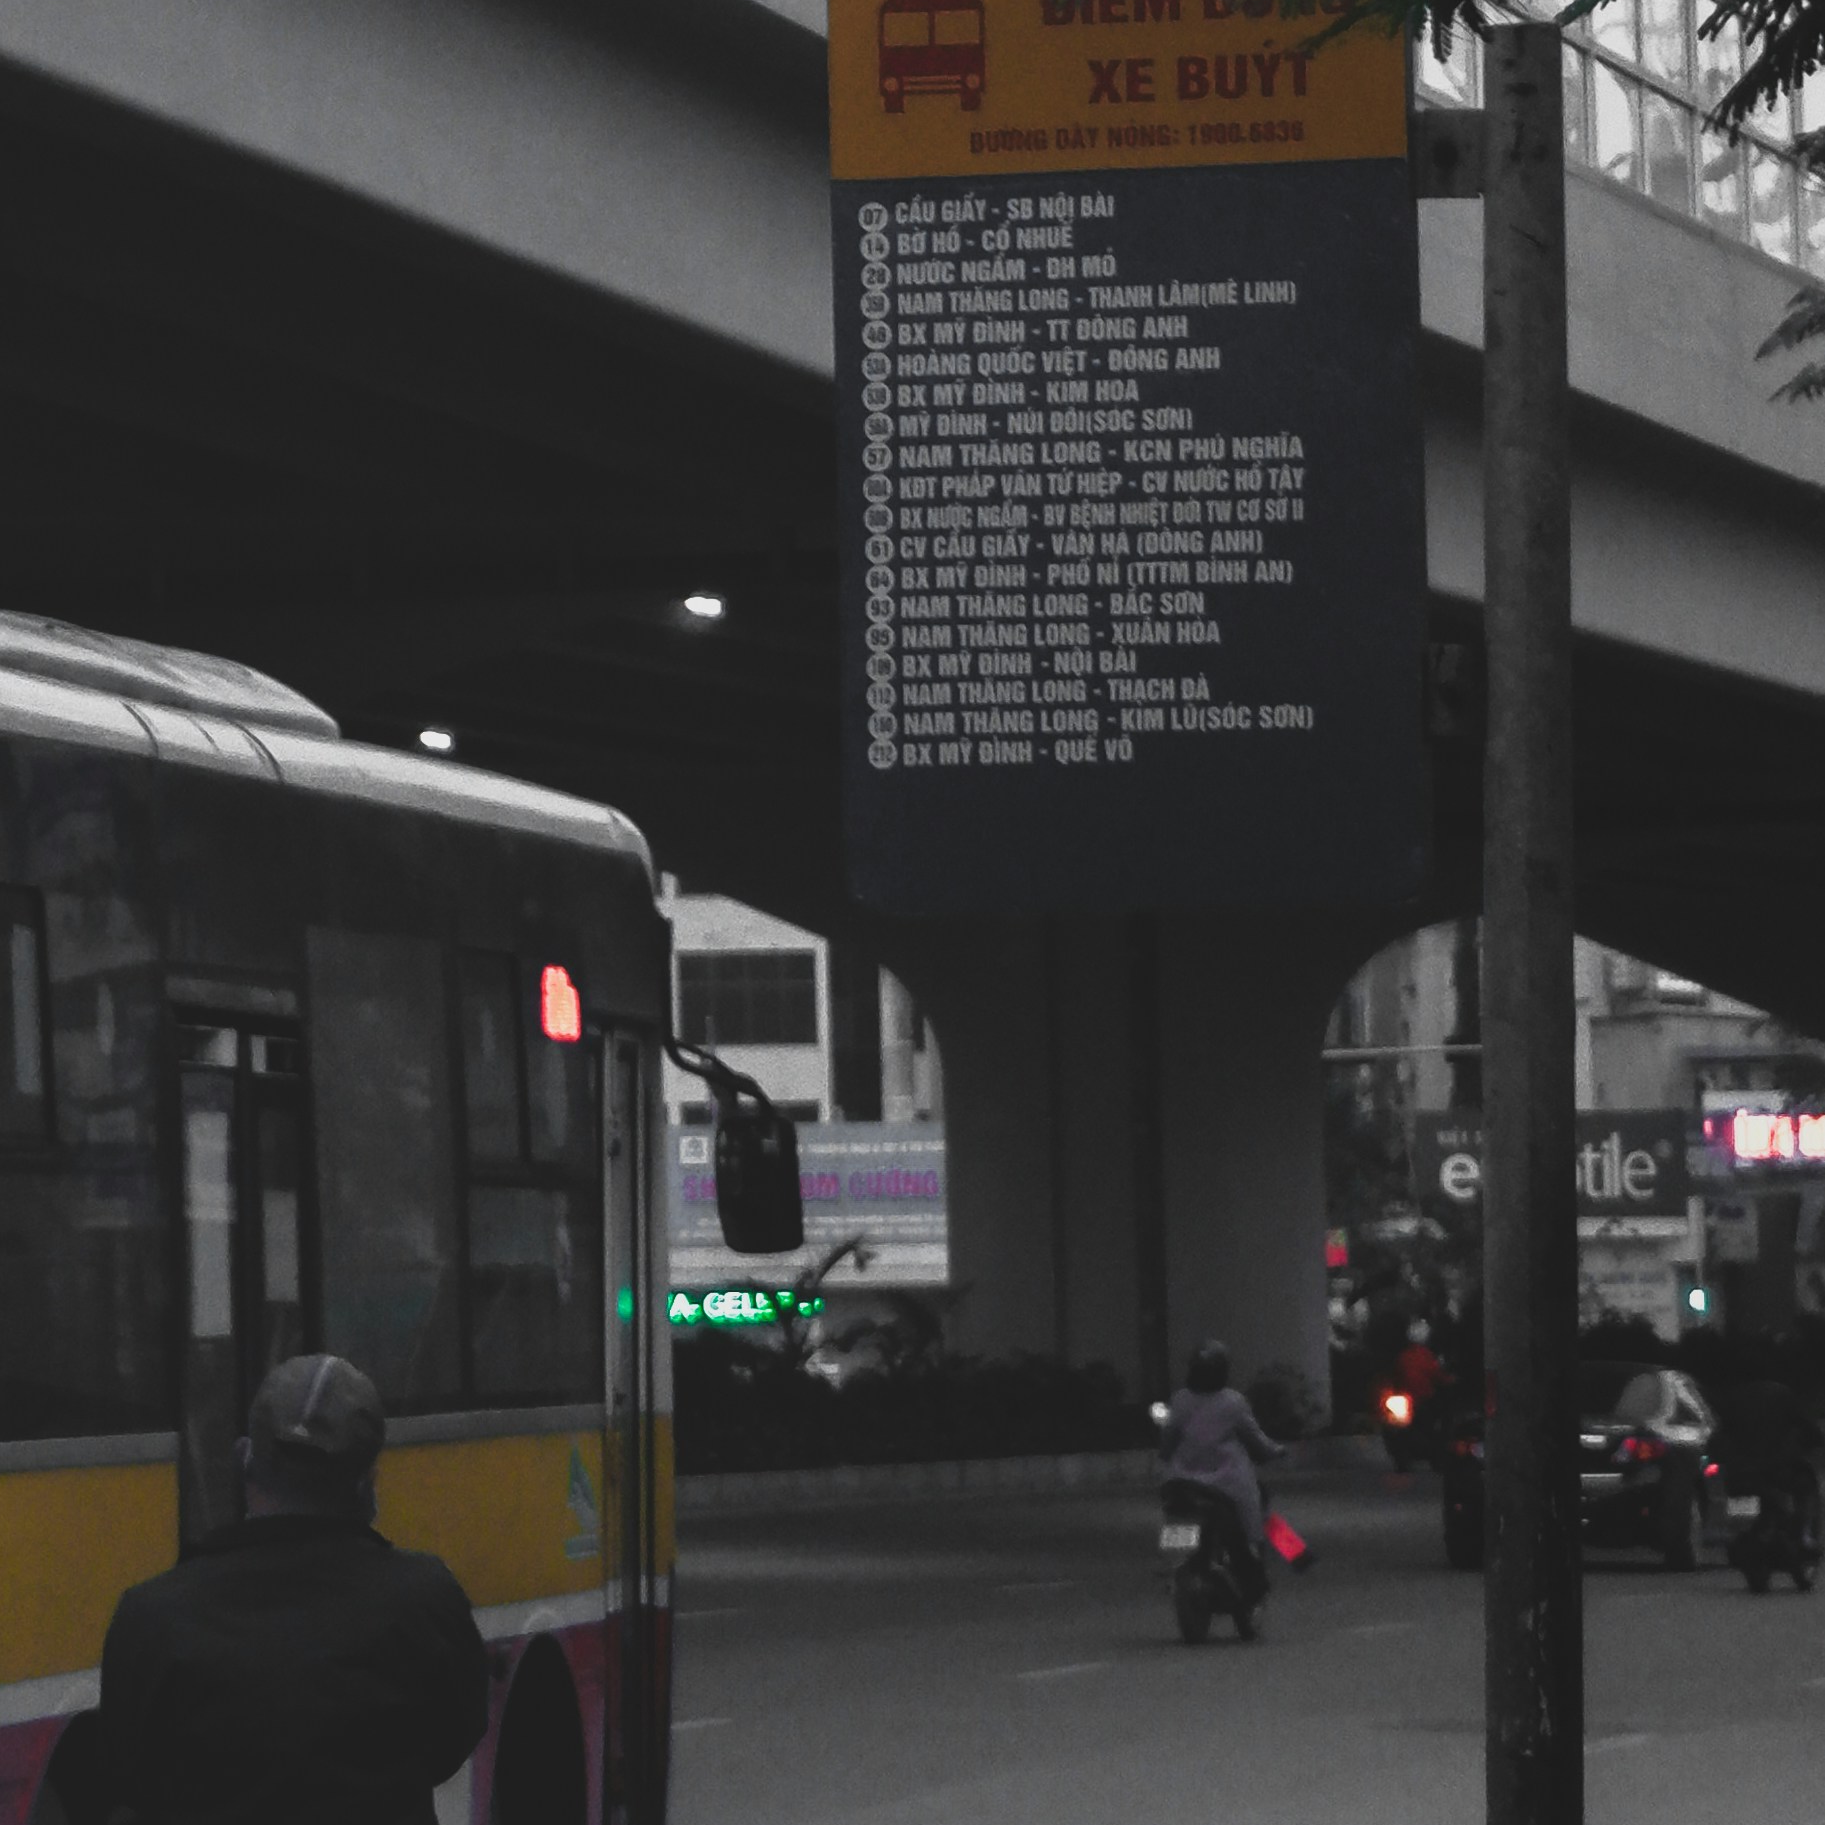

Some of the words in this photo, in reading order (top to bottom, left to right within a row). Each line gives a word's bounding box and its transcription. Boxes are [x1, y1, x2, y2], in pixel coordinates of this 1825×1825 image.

[1088, 58, 1155, 104] XE
[1177, 39, 1313, 100] BUÝT
[1007, 198, 1033, 219] SB
[1080, 190, 1115, 217] BÀI
[897, 292, 943, 314] NAM
[1018, 288, 1069, 312] LONG
[1088, 285, 1153, 308] THANH
[897, 323, 927, 345] BX
[1046, 319, 1071, 341] TT
[1142, 316, 1189, 339] ANH
[1174, 346, 1221, 370] ANH
[897, 384, 927, 407] BX
[1046, 380, 1089, 404] KIM
[1095, 379, 1139, 402] HOA
[899, 444, 952, 468] NAM
[1041, 441, 1101, 465] LONG
[1123, 439, 1173, 462] KCN
[1142, 470, 1168, 493] CV
[900, 535, 927, 559] CV
[901, 567, 930, 589] BX
[901, 595, 951, 618] NAM
[1033, 593, 1090, 617] LONG
[902, 624, 952, 648] NAM
[1033, 622, 1090, 646] LONG
[902, 654, 932, 678] BX
[903, 682, 952, 705] NAM
[1032, 680, 1087, 703] LONG
[904, 711, 956, 735] NAM
[1040, 708, 1098, 732] LONG
[1120, 707, 1165, 731] KIM
[903, 743, 933, 767] BX
